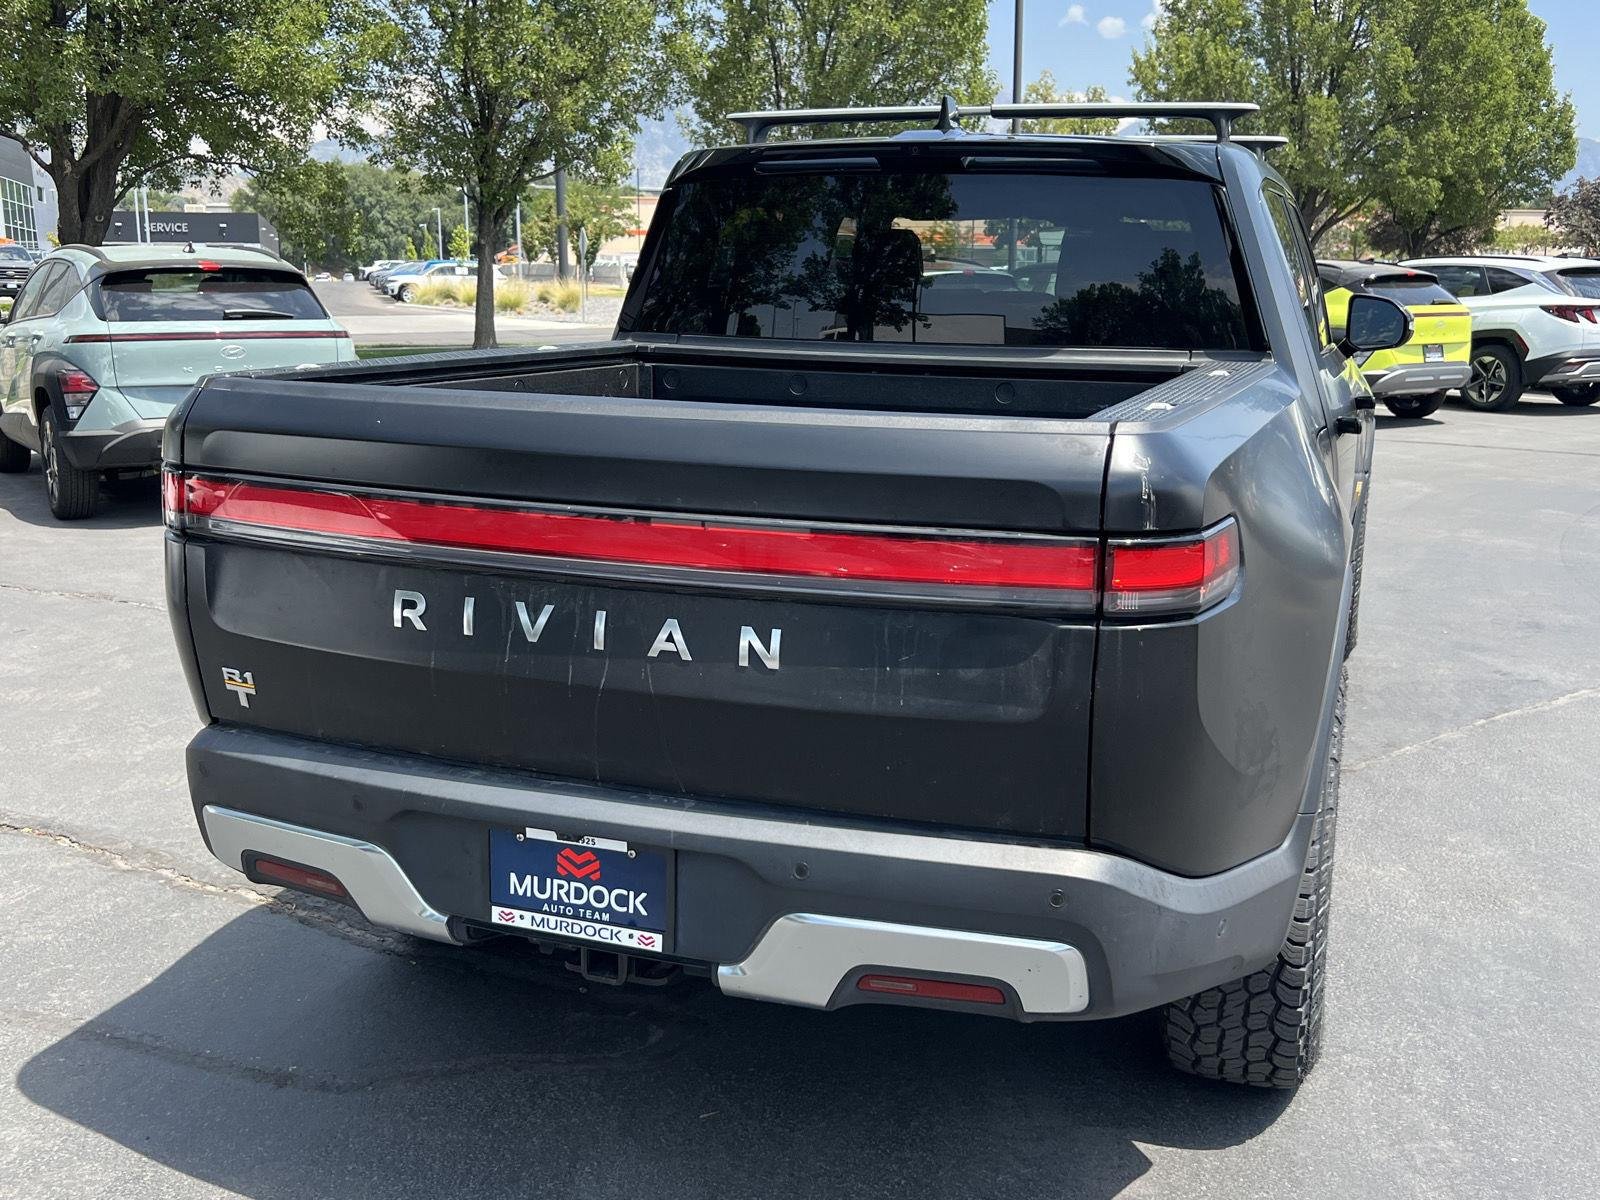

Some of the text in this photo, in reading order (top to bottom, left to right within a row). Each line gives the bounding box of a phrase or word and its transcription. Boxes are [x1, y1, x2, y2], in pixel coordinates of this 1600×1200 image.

[393, 589, 782, 670] RIVIAN
[509, 872, 648, 916] MURDOCK
[531, 915, 622, 943] MURDOCK
[542, 903, 610, 922] AUTO TEAM
